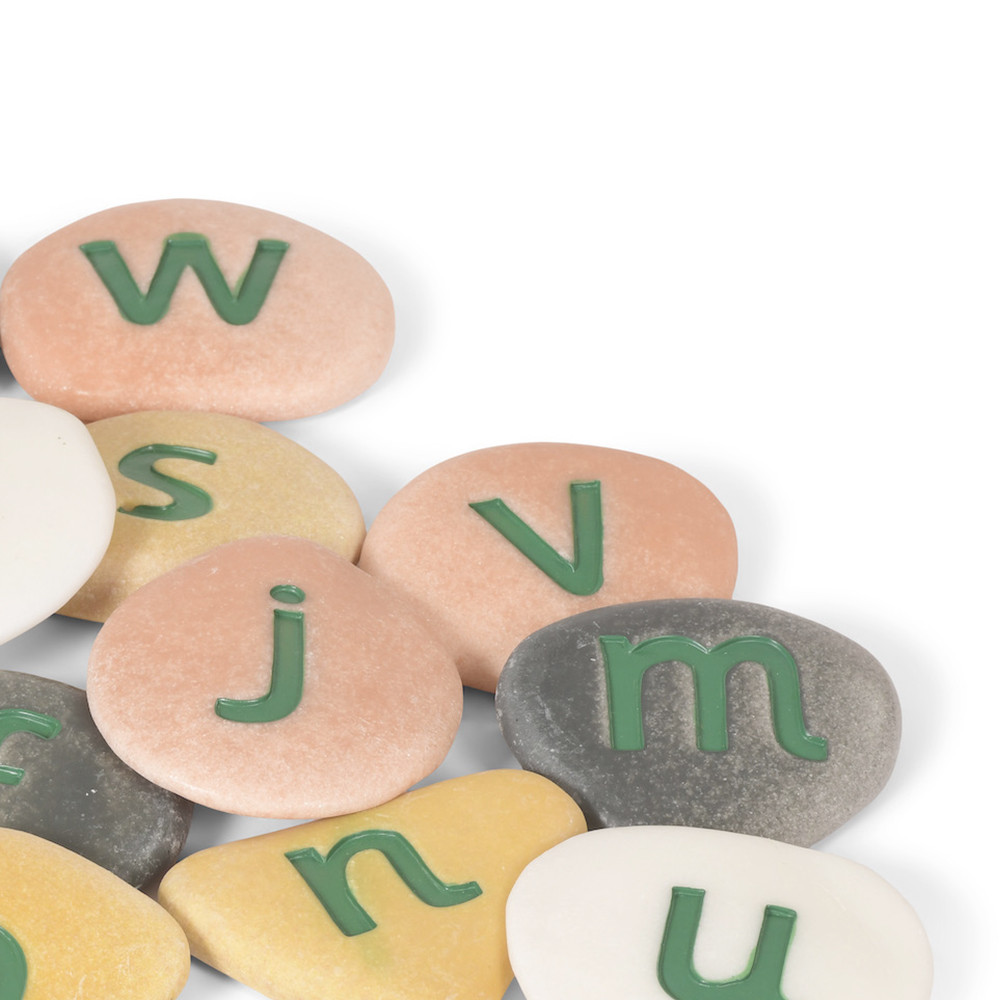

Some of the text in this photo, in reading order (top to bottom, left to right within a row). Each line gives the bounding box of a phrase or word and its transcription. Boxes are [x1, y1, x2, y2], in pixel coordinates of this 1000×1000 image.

[80, 233, 290, 325] w
[117, 443, 217, 521] s
[468, 480, 604, 596] v
[214, 584, 306, 723] j
[599, 634, 827, 763] m
[285, 829, 483, 937] n
